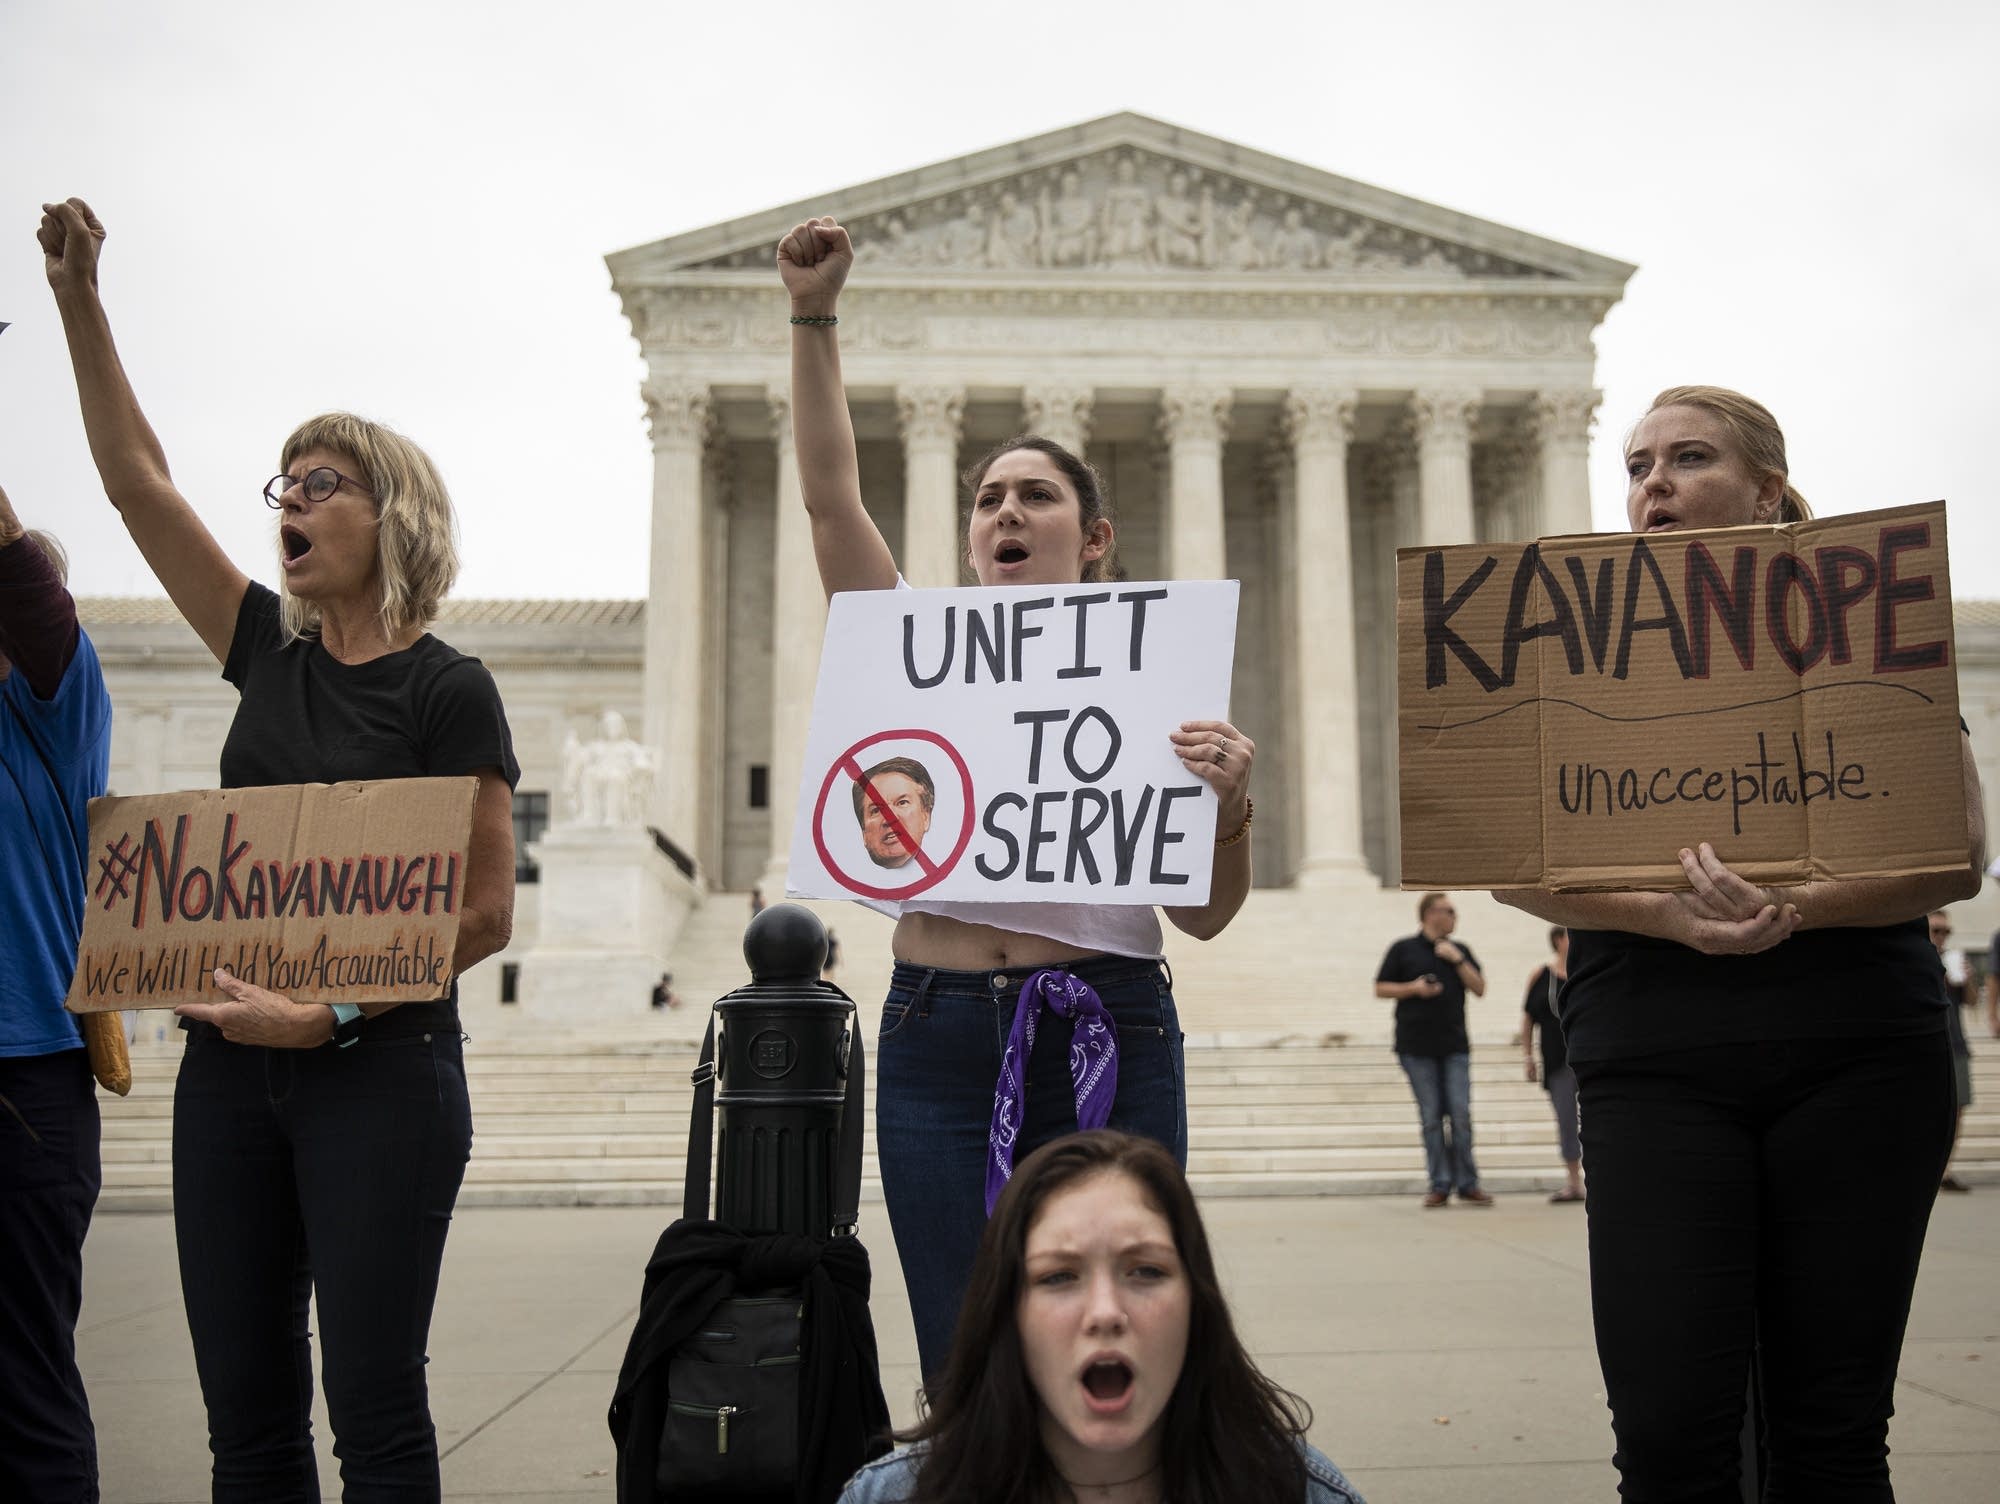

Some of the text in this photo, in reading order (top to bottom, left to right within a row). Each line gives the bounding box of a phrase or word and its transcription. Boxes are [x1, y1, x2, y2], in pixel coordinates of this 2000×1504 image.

[903, 588, 1168, 689] UNFIT
[1423, 522, 1950, 693] KAVANOPE
[1013, 705, 1122, 784] TO
[1559, 731, 1891, 835] unacceptable.
[975, 784, 1203, 887] SERVE
[86, 952, 129, 996] We
[136, 948, 187, 994] Will
[266, 945, 307, 989] You
[305, 934, 444, 989] Accountable
